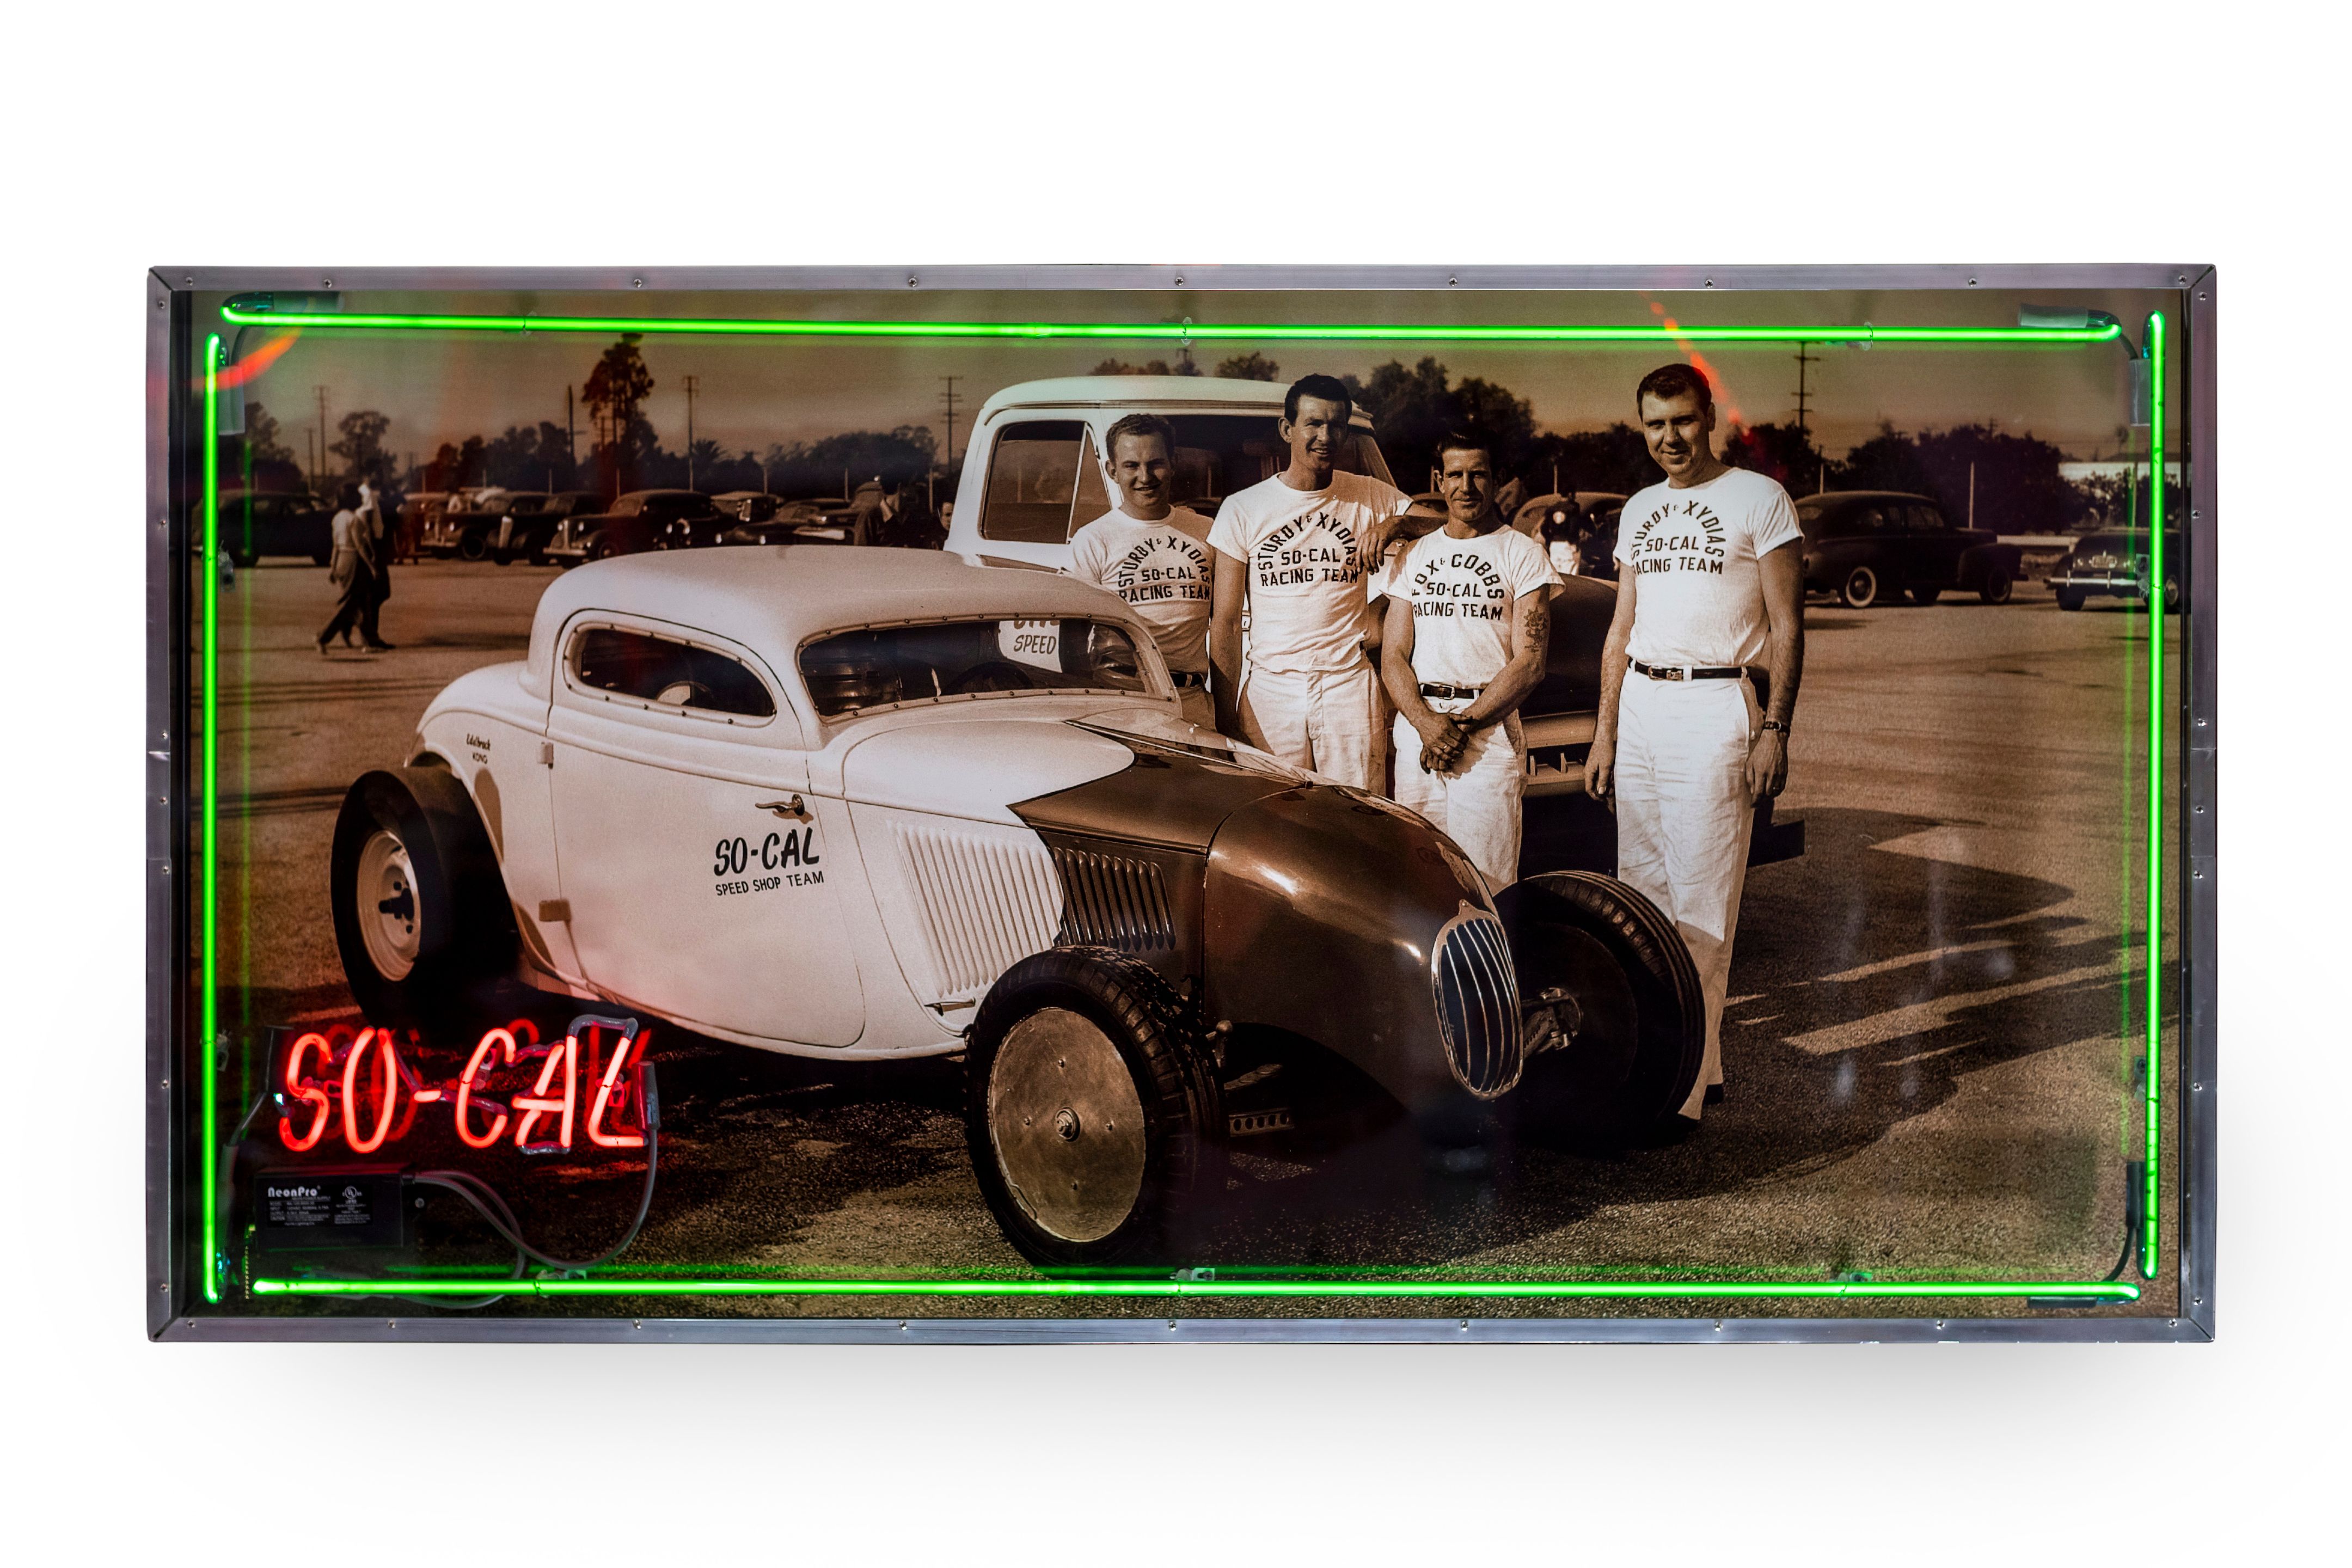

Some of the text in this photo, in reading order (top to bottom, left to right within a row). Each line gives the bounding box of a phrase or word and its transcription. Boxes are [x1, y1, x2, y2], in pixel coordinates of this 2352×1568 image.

[1683, 500, 1726, 557] XYDIAS
[1258, 516, 1303, 571] STURDY
[1315, 512, 1357, 567] XYDIAS
[1645, 536, 1699, 552] SO-CAL
[1118, 538, 1156, 587] STURDY
[1167, 535, 1210, 585] XYDIAS
[1281, 548, 1340, 566] SO-CAL
[1679, 556, 1723, 574] TEAM
[1142, 566, 1196, 582] SO-CAL
[1260, 568, 1359, 586] RACING TEAM
[1412, 559, 1440, 597] FOX
[1451, 554, 1504, 599] COBBS
[1179, 585, 1210, 600] TEAM
[1426, 582, 1481, 597] SO-CAL
[1461, 603, 1503, 621] TEAM
[1013, 634, 1057, 654] SPEED
[714, 826, 819, 876] SO-CAL
[715, 871, 824, 896] SPEED SHOP TEAM
[279, 1027, 645, 1152] SO-CAL
